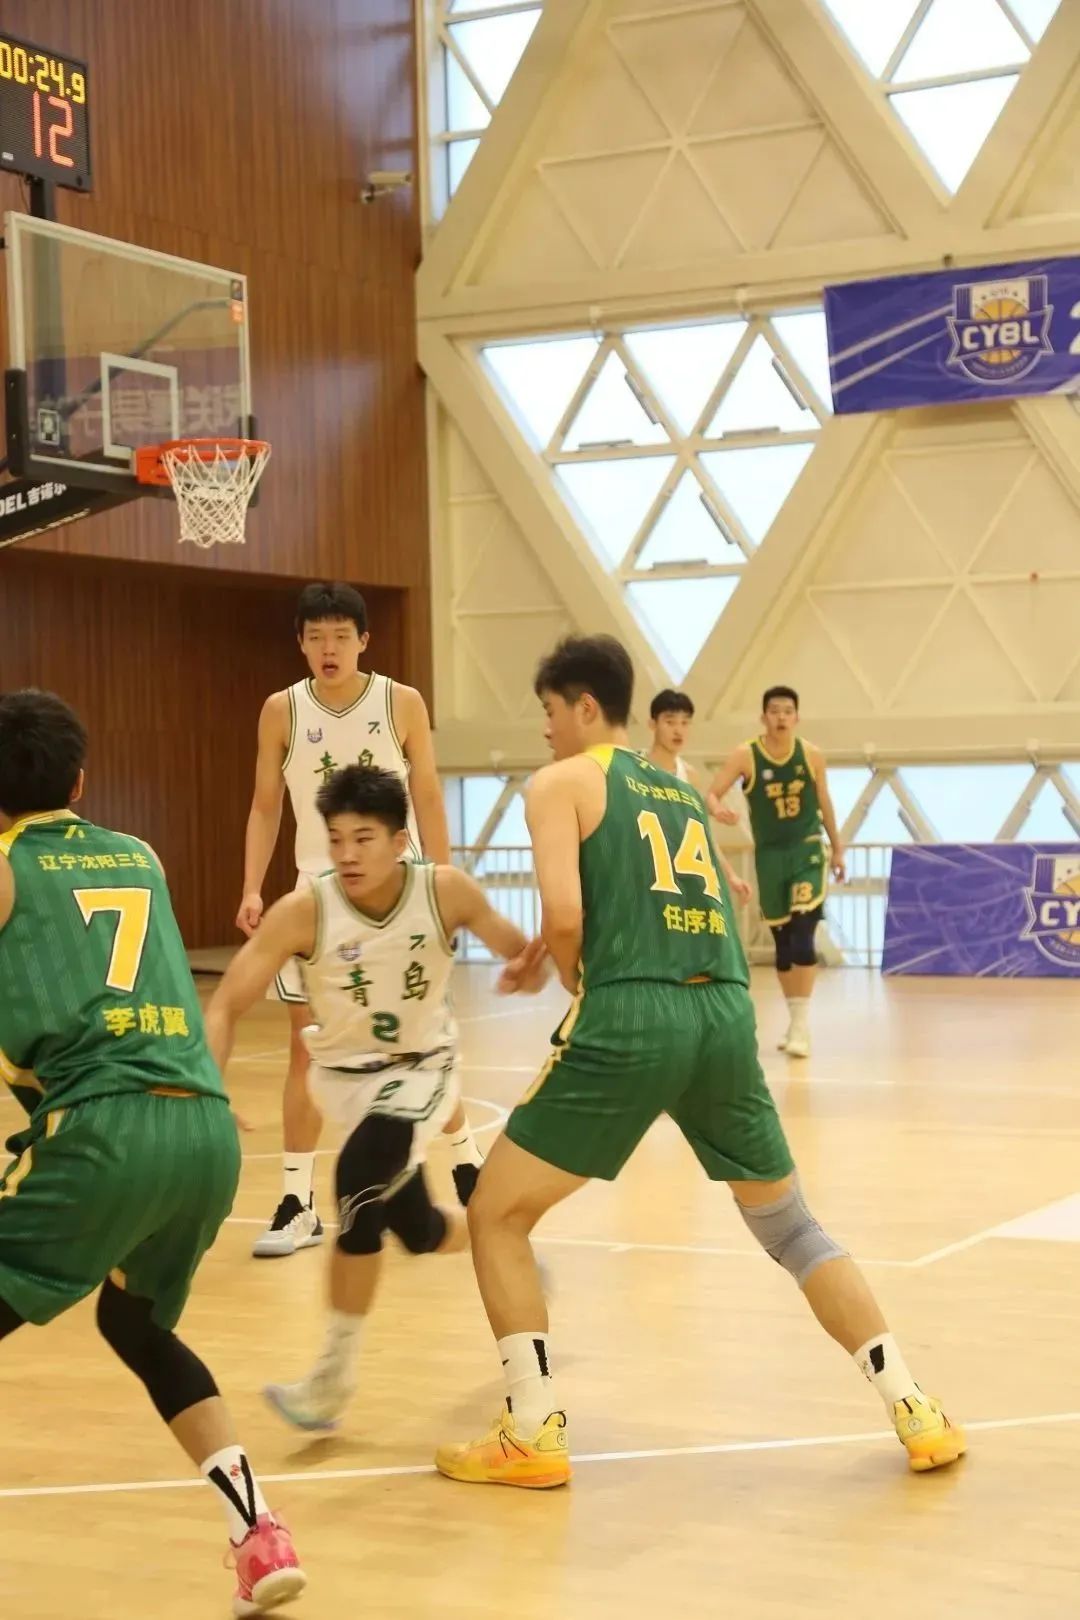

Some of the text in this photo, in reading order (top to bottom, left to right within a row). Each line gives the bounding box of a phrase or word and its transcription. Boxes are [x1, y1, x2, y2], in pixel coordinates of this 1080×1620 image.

[0, 41, 86, 104] 00:24.9
[33, 90, 75, 168] 12
[962, 320, 1040, 351] CYBL
[37, 852, 152, 871] 辽宁沈阳三生
[636, 809, 723, 905] 14
[72, 886, 153, 994] 7
[339, 961, 430, 1007] 青岛
[371, 1011, 401, 1044] 2
